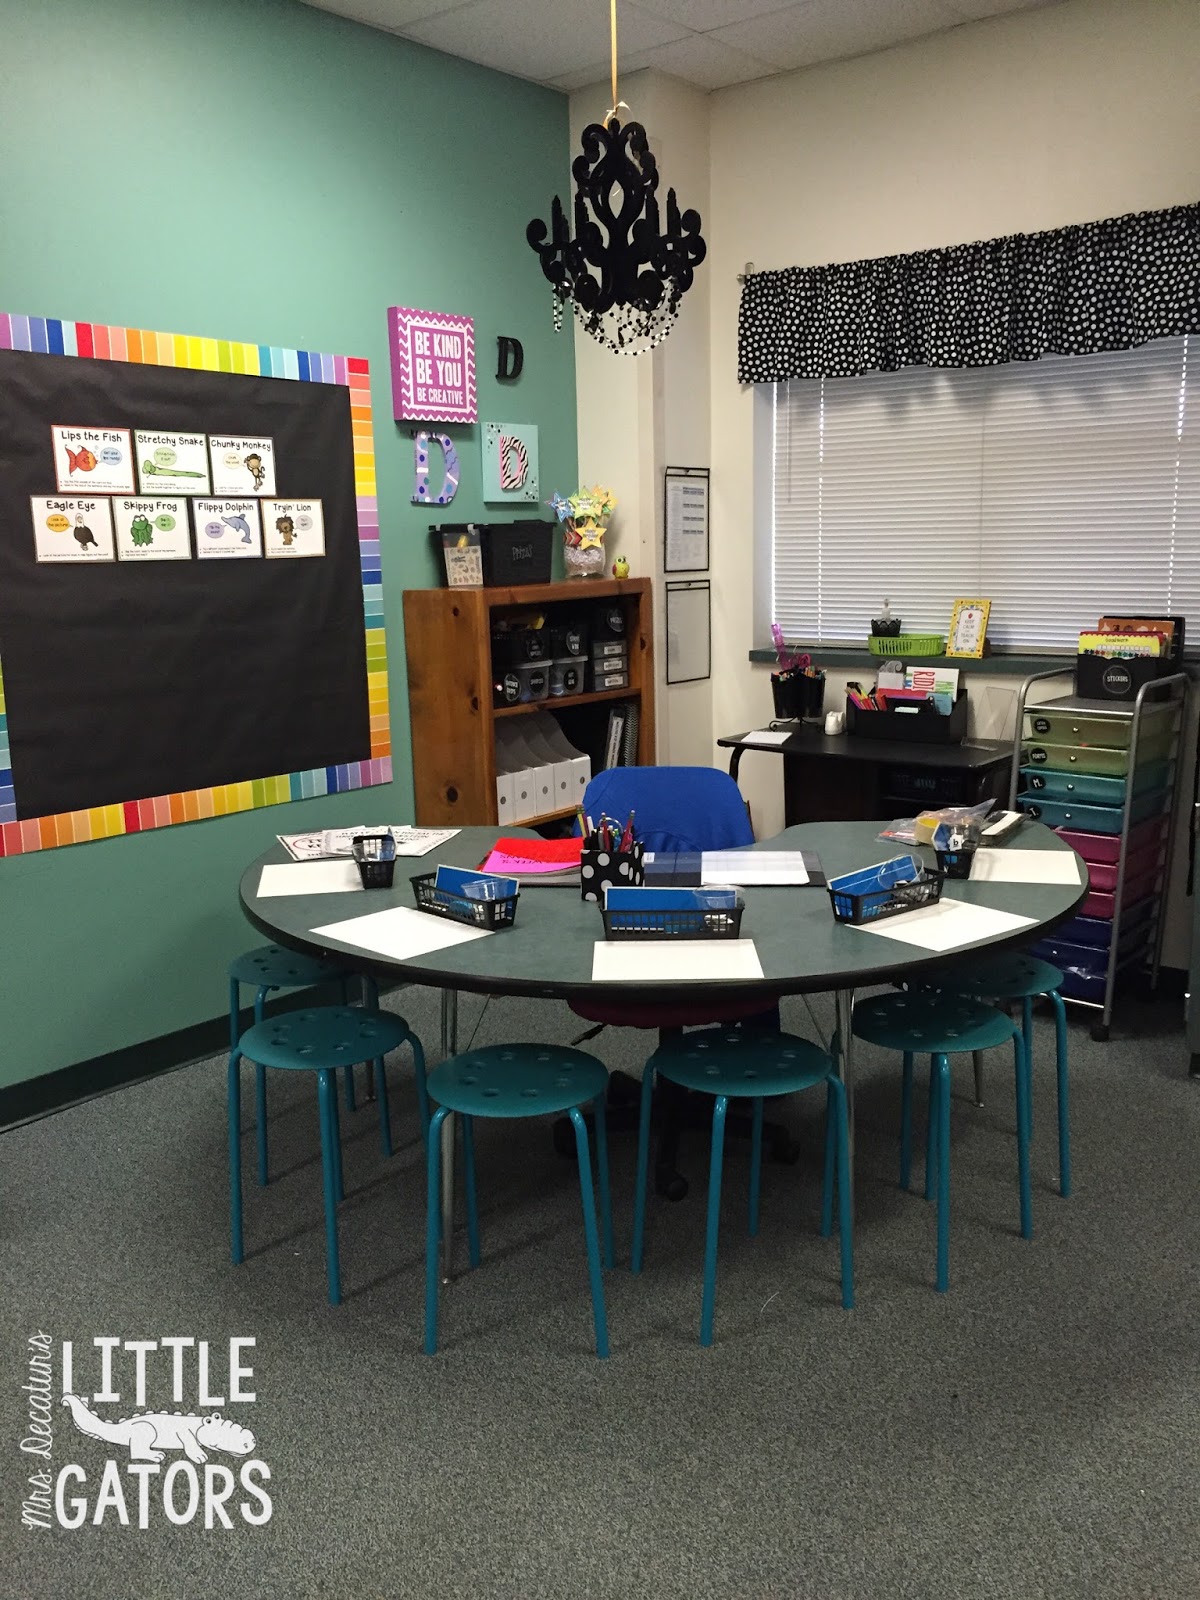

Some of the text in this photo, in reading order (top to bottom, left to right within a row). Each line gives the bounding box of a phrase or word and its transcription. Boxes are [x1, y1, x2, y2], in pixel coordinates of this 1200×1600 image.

[414, 330, 462, 360] BE KIND
[495, 336, 524, 380] D
[416, 357, 462, 388] BE YOU
[417, 387, 464, 406] BE CREATIVE
[61, 431, 122, 442] Lips the Fish
[137, 434, 204, 447] Stretchy Snake
[210, 439, 271, 452] Chunky Monkey
[411, 430, 460, 504] D
[499, 435, 529, 490] D
[46, 500, 96, 512] Eagle Eye
[123, 500, 177, 512] Skippy Frog
[198, 502, 254, 513] Flippy Dolphin
[273, 503, 312, 513] Tryin' Lion
[1106, 675, 1129, 683] STICKERS
